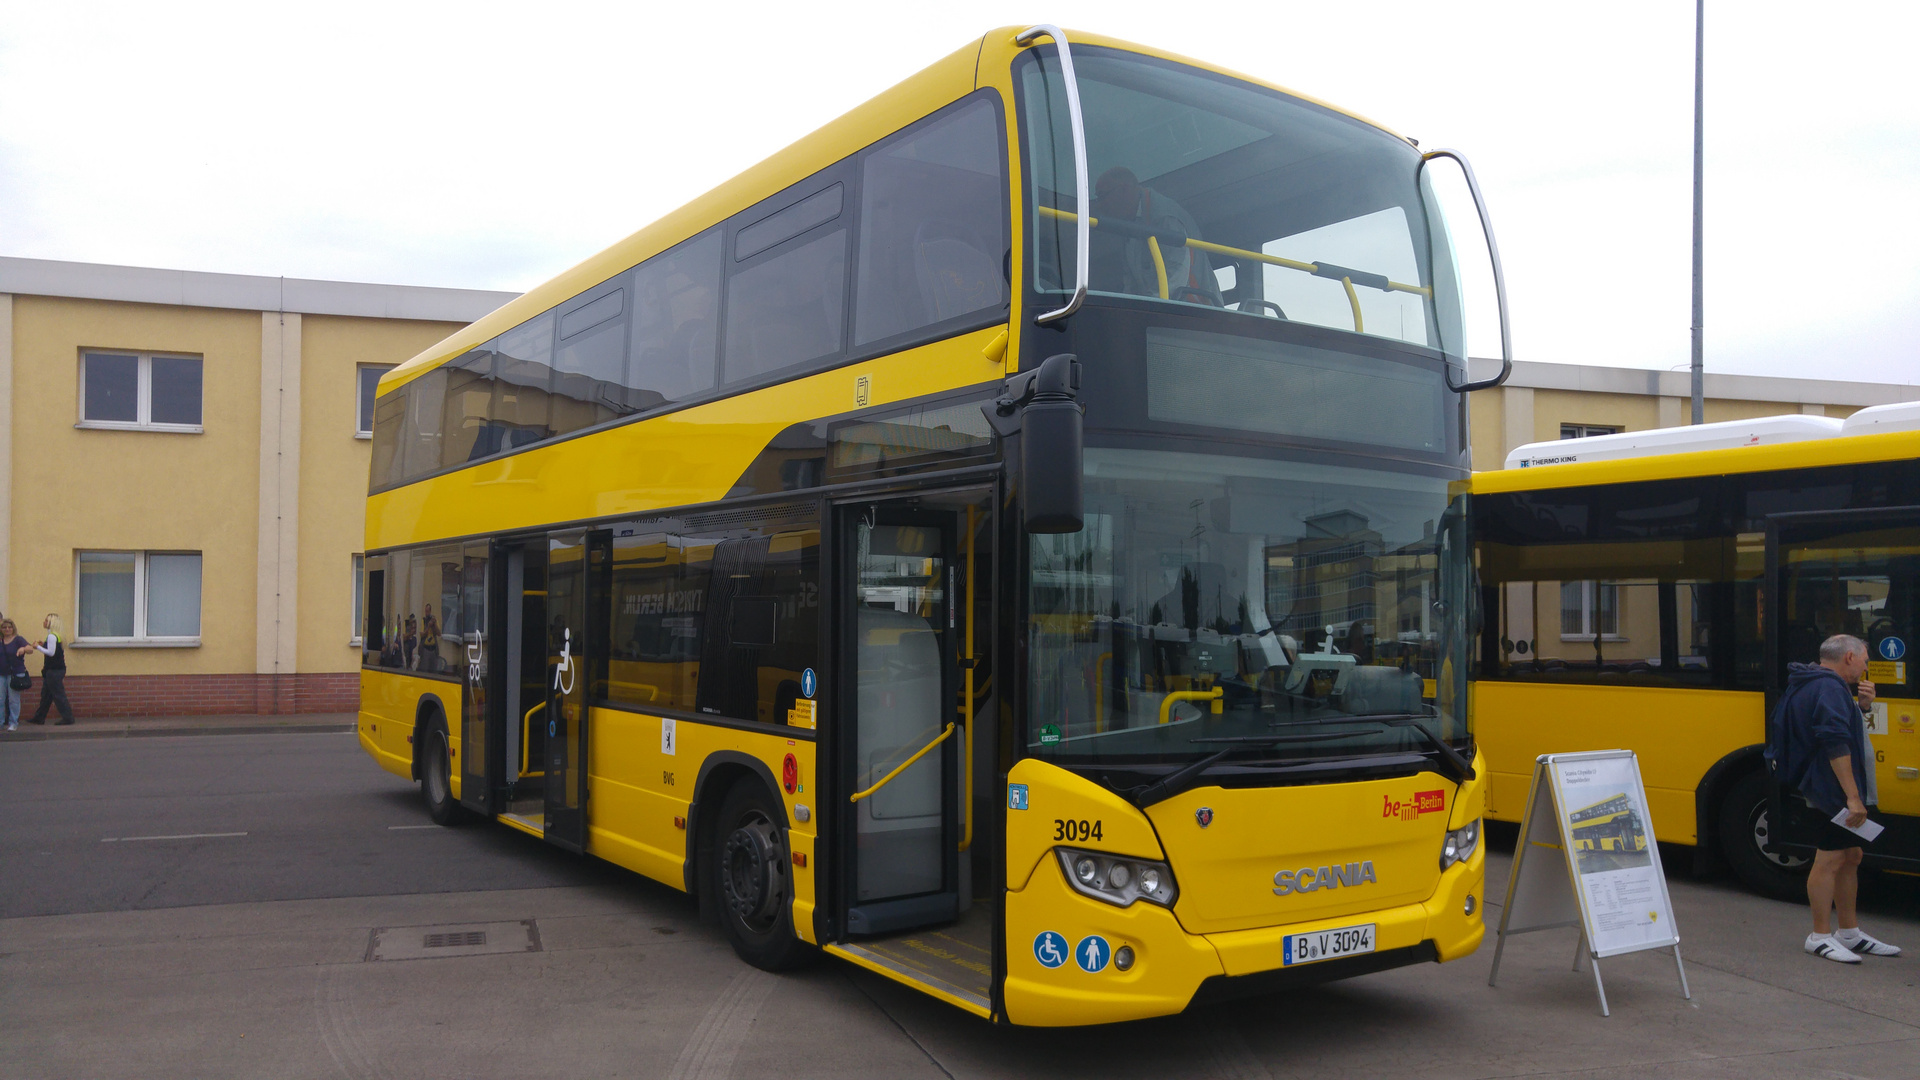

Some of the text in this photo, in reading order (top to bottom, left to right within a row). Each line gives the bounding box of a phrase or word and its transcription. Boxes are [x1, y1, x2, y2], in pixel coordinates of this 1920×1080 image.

[1532, 457, 1559, 466] THERMO
[663, 770, 675, 786] BVG
[1382, 795, 1443, 818] be Berlin
[1053, 819, 1103, 842] 3094
[1272, 860, 1377, 896] SCANIA
[1299, 928, 1369, 959] B V 3094
